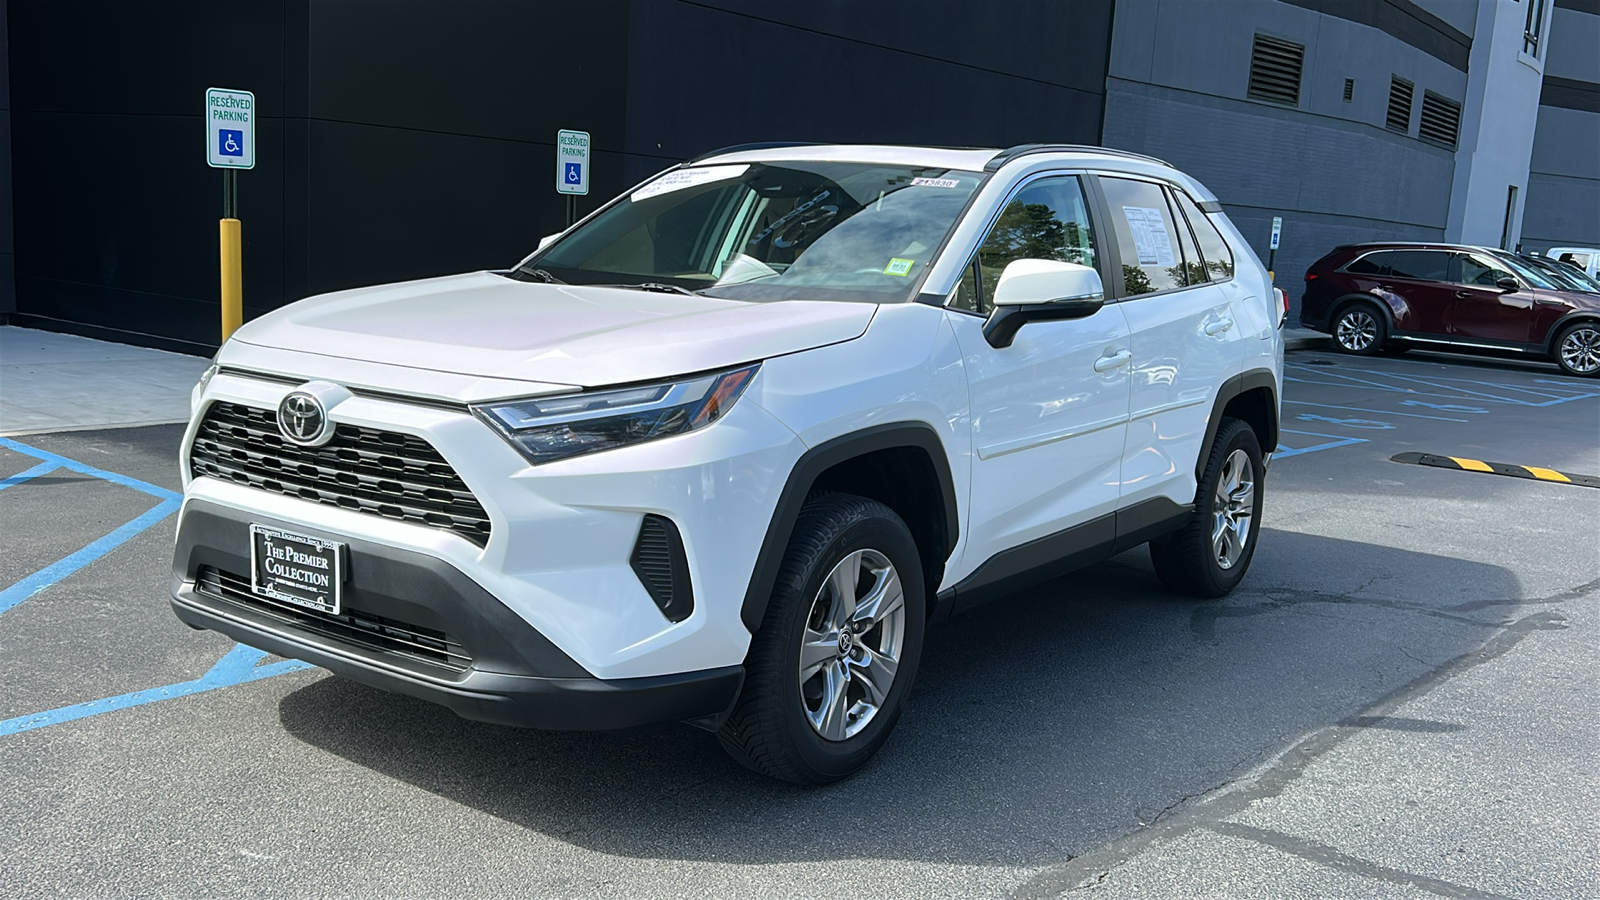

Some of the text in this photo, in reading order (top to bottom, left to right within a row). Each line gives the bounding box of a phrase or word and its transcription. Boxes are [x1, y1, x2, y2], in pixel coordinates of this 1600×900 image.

[210, 96, 251, 110] RESERVED
[213, 110, 248, 122] PARKING
[560, 136, 588, 147] RESERVED
[562, 147, 586, 157] PARKING
[264, 540, 329, 570] THE PREMIER
[265, 557, 329, 587] COLLECTION
